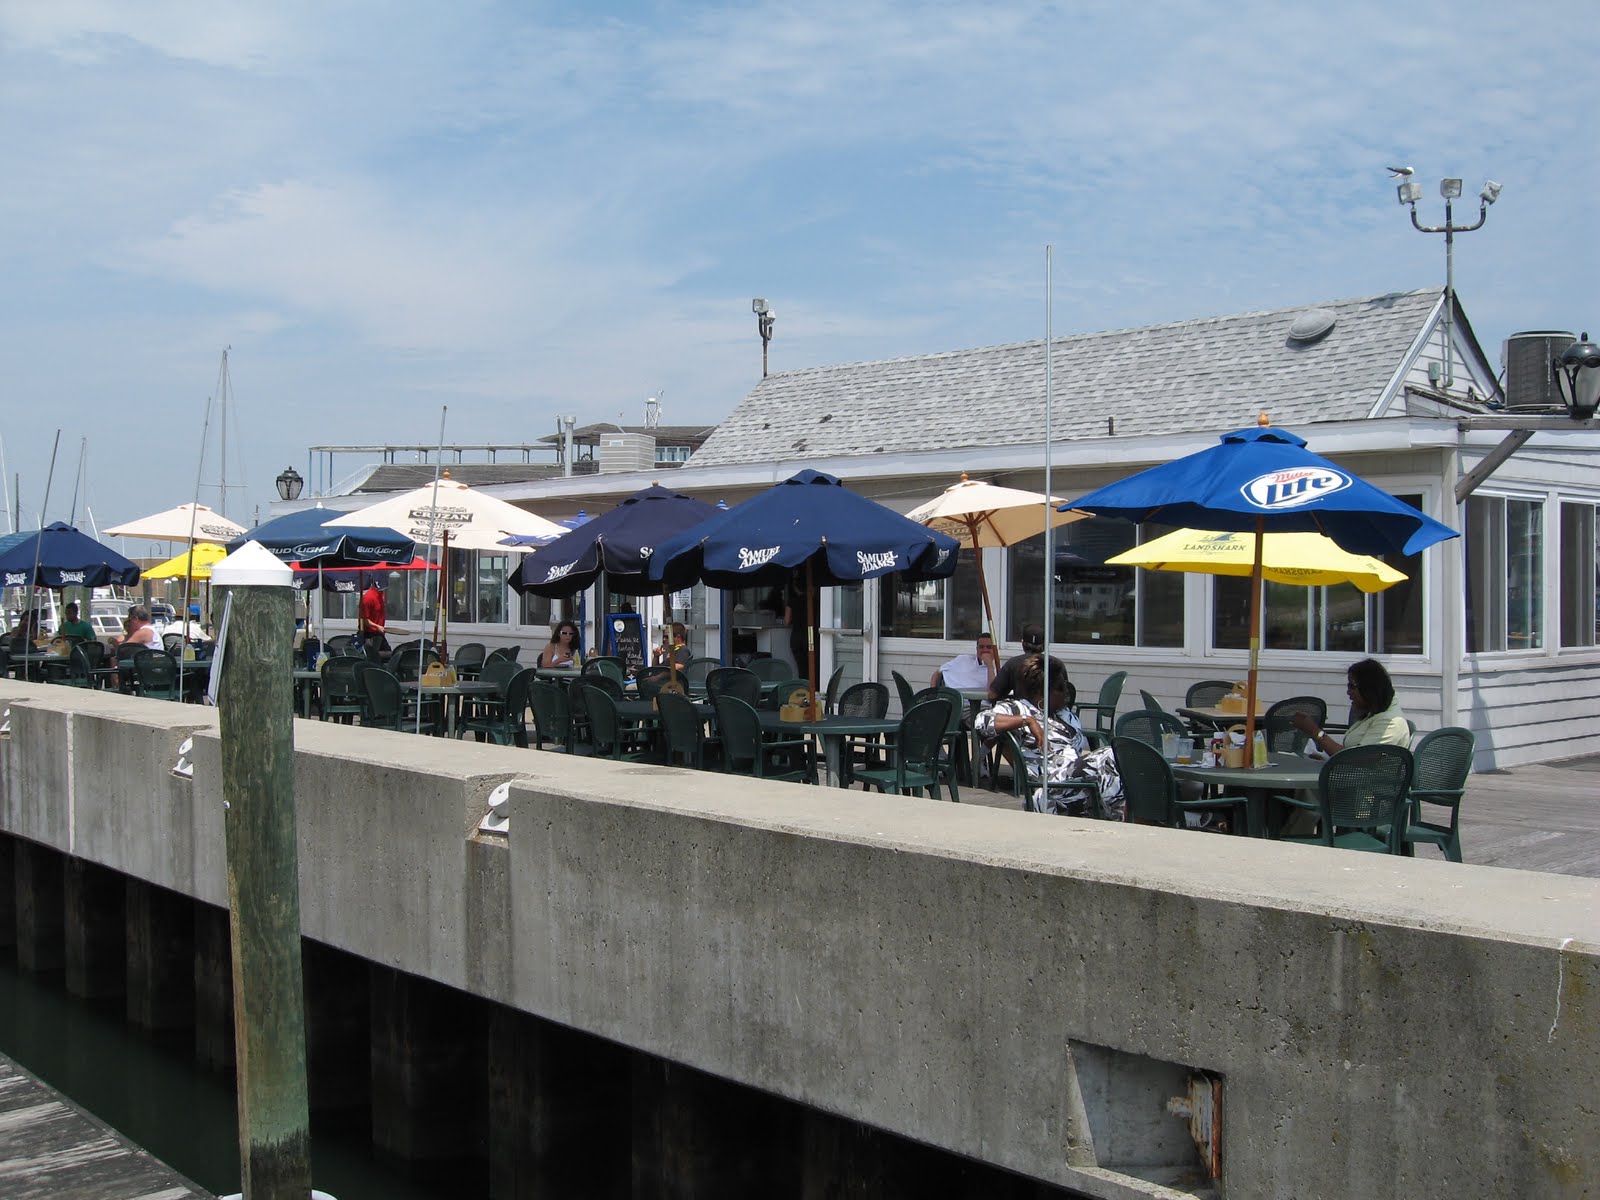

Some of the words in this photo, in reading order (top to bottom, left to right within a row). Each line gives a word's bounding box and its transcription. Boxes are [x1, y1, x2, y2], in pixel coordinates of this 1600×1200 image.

[411, 511, 470, 520] CRUZAN
[738, 545, 781, 559] SAMUEL
[856, 550, 899, 563] SAMUEL
[861, 558, 896, 575] ADAMS
